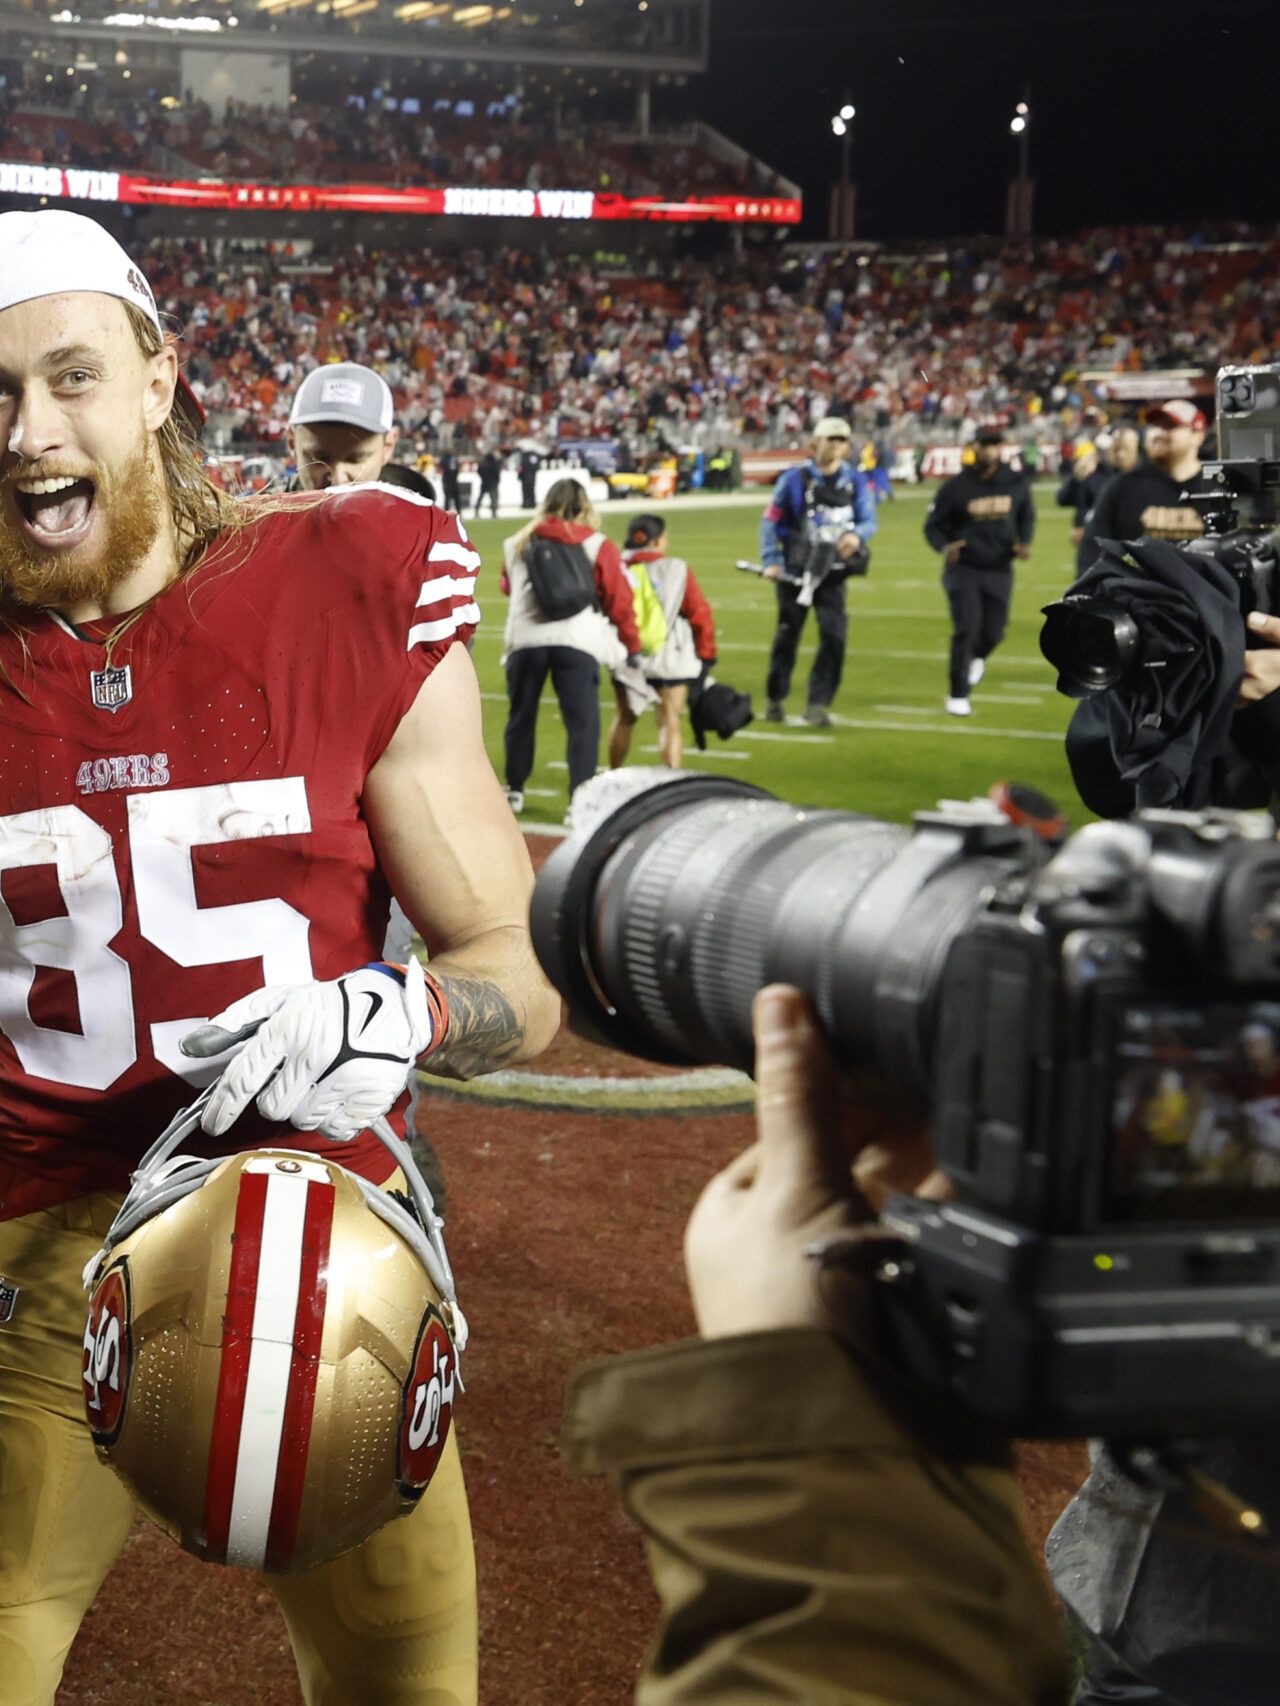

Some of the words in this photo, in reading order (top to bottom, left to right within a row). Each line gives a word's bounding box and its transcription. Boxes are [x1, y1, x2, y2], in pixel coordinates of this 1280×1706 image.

[65, 168, 120, 201] WIN
[444, 188, 535, 217] NINERS
[537, 190, 596, 219] WIN
[95, 682, 128, 706] NFL
[75, 752, 171, 795] 49ERS
